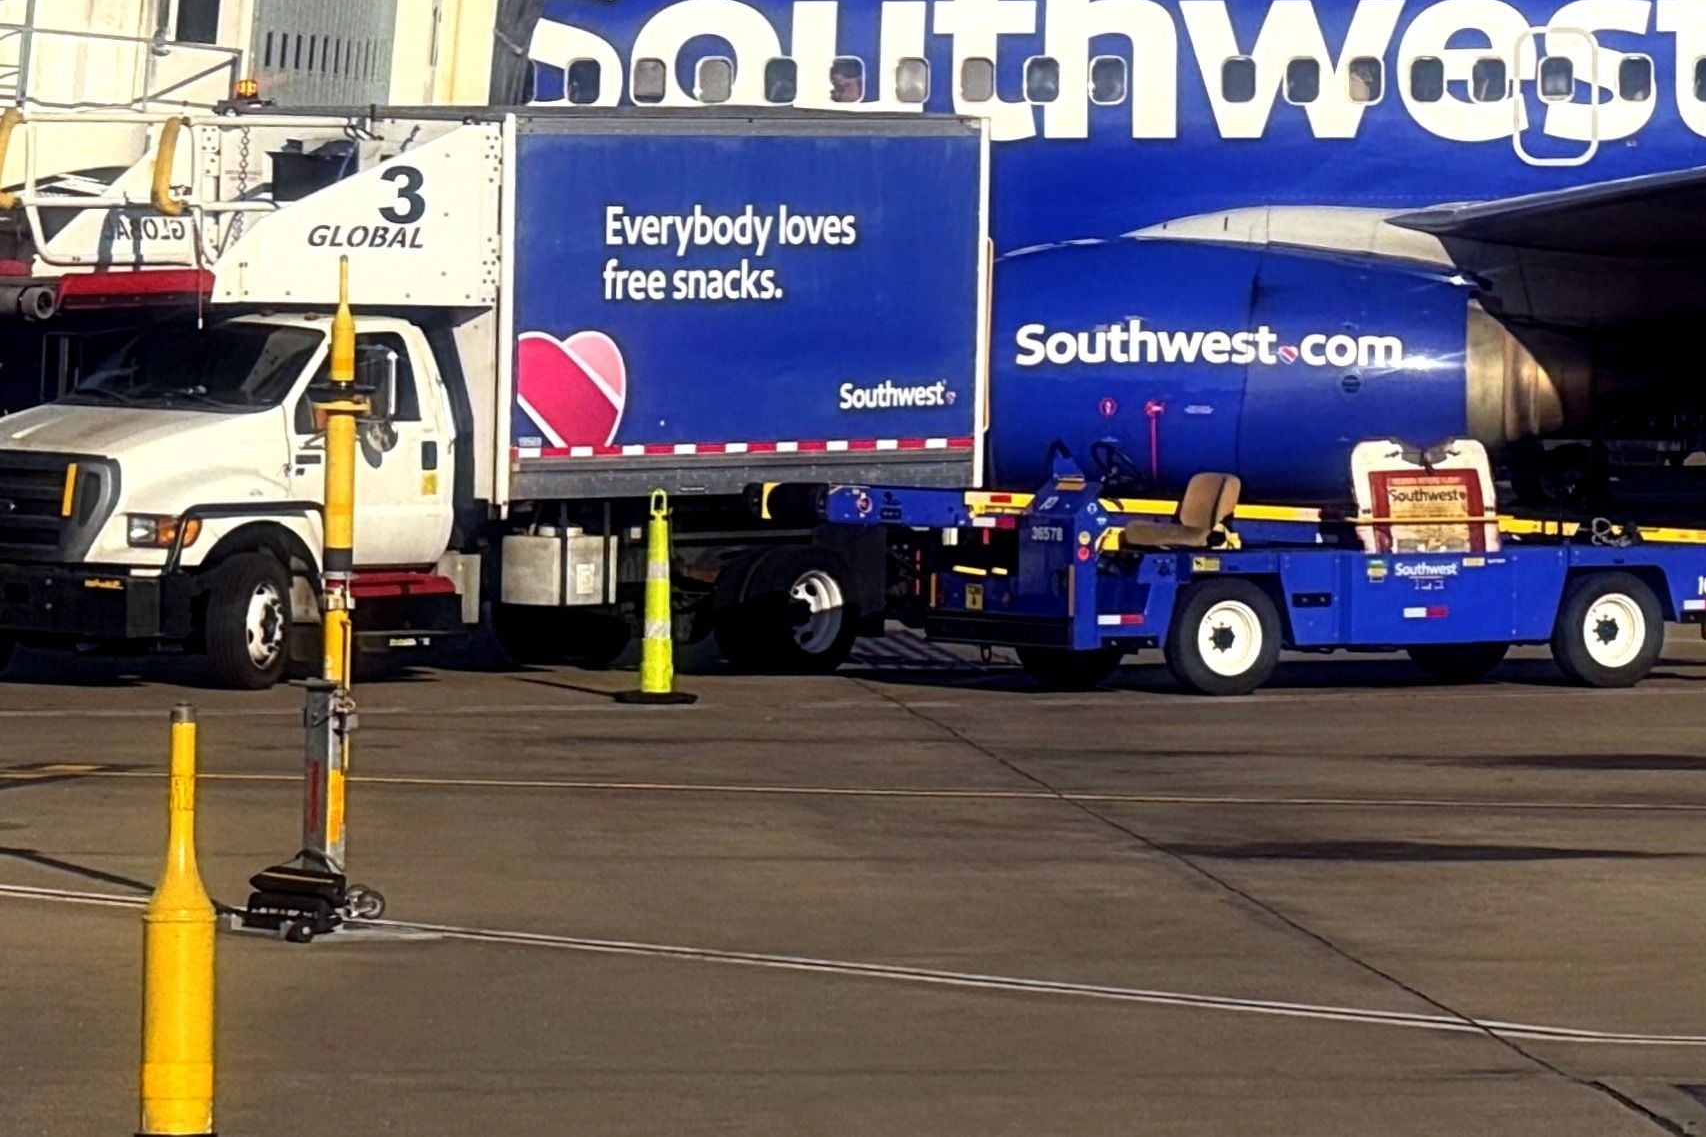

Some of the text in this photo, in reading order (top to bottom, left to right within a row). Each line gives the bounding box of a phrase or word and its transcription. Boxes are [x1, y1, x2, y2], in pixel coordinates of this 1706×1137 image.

[377, 165, 426, 225] 3
[307, 224, 424, 249] GLOBAL
[605, 204, 857, 257] Everybody loves
[602, 258, 783, 301] free snacks.
[838, 379, 945, 410] Southwest
[1388, 488, 1458, 503] Southwest
[1394, 561, 1458, 576] Southwest
